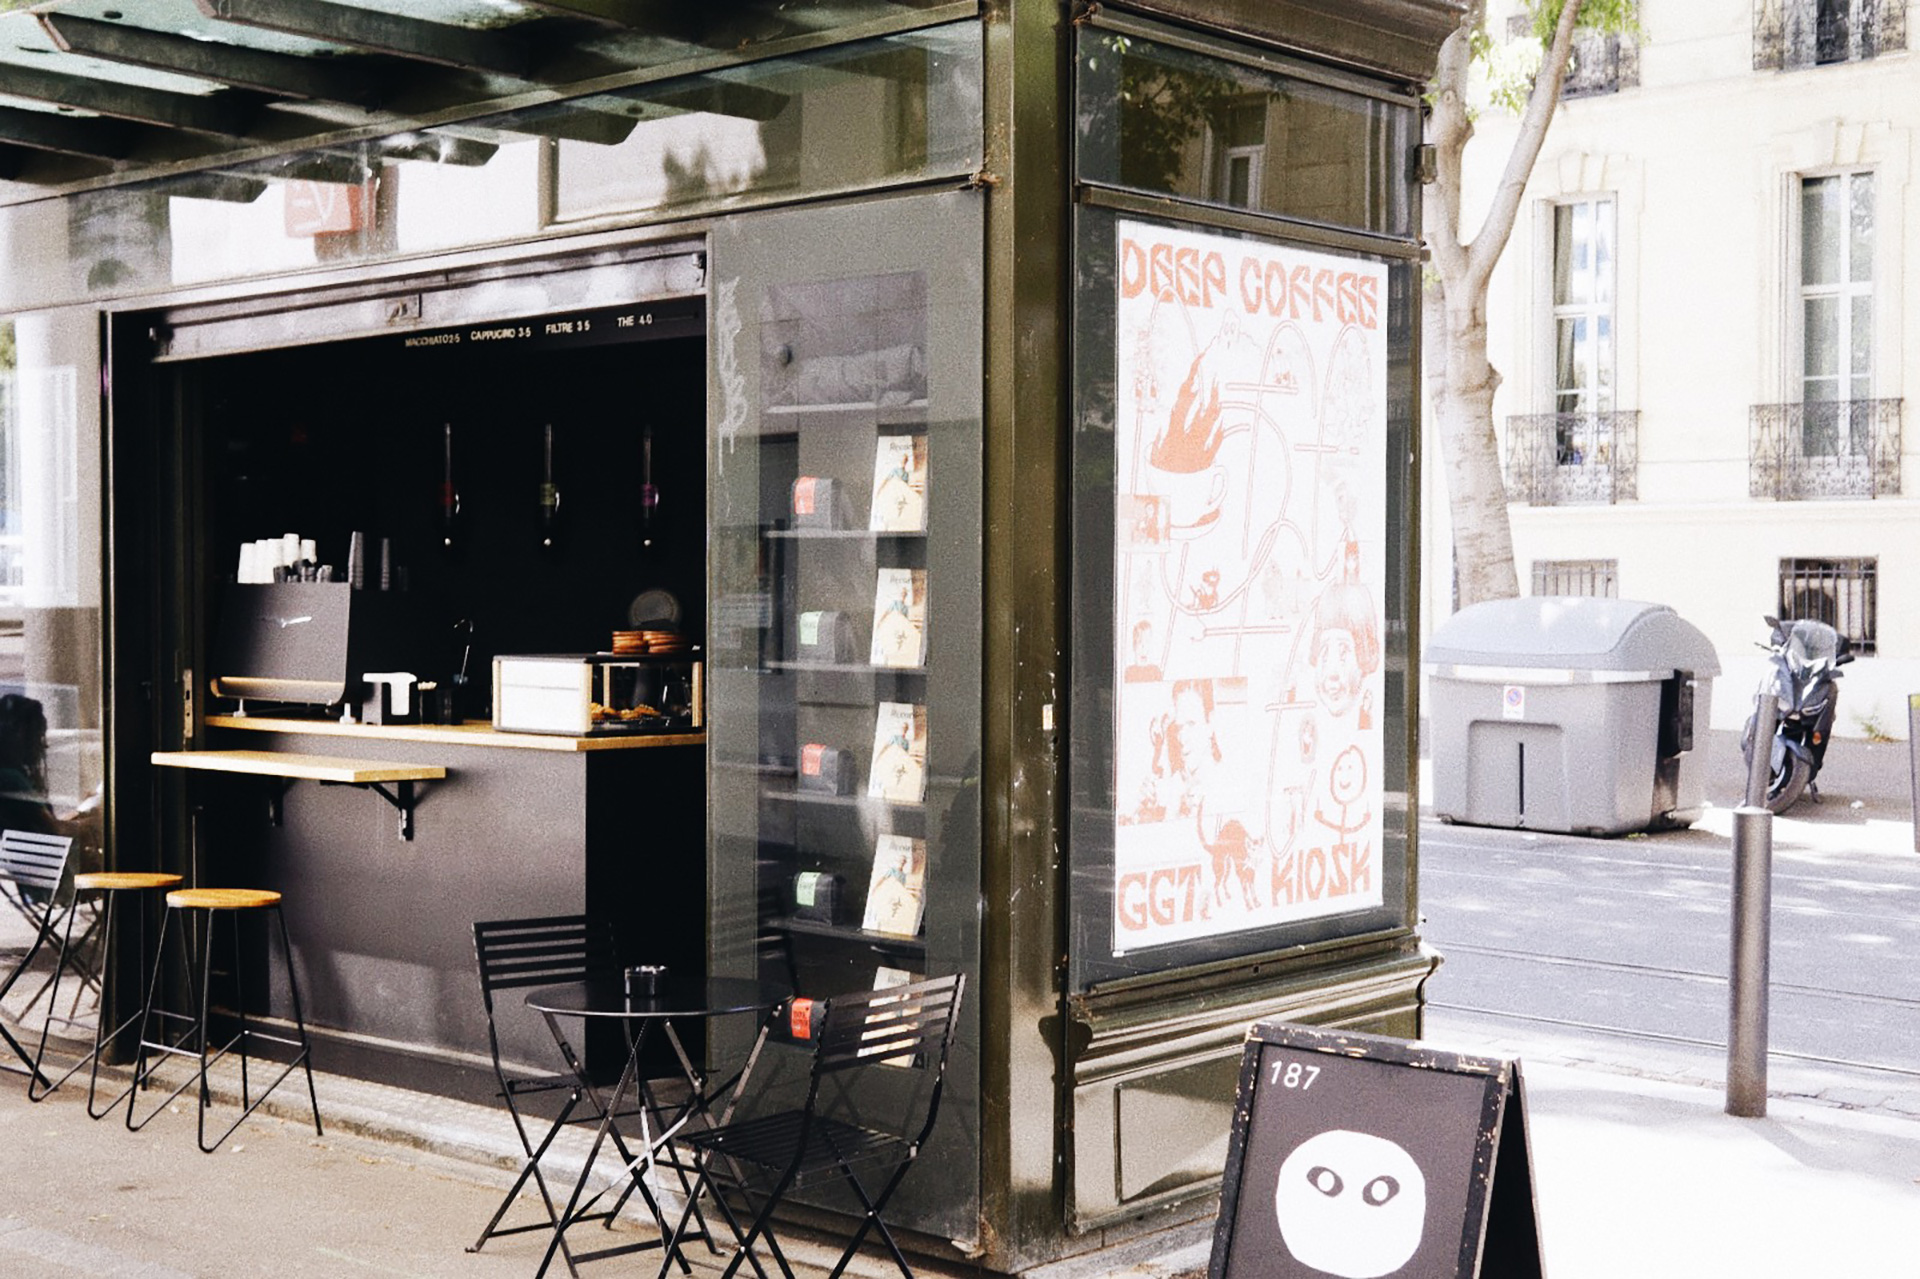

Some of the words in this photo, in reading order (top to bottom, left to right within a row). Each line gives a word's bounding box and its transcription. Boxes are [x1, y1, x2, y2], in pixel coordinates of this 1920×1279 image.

[1121, 238, 1227, 308] DEEP
[1239, 256, 1378, 330] COFFEE
[545, 322, 573, 335] FILTRE
[1117, 864, 1202, 931] GGT
[1271, 839, 1371, 908] KIOSK
[1270, 1060, 1321, 1091] 187
